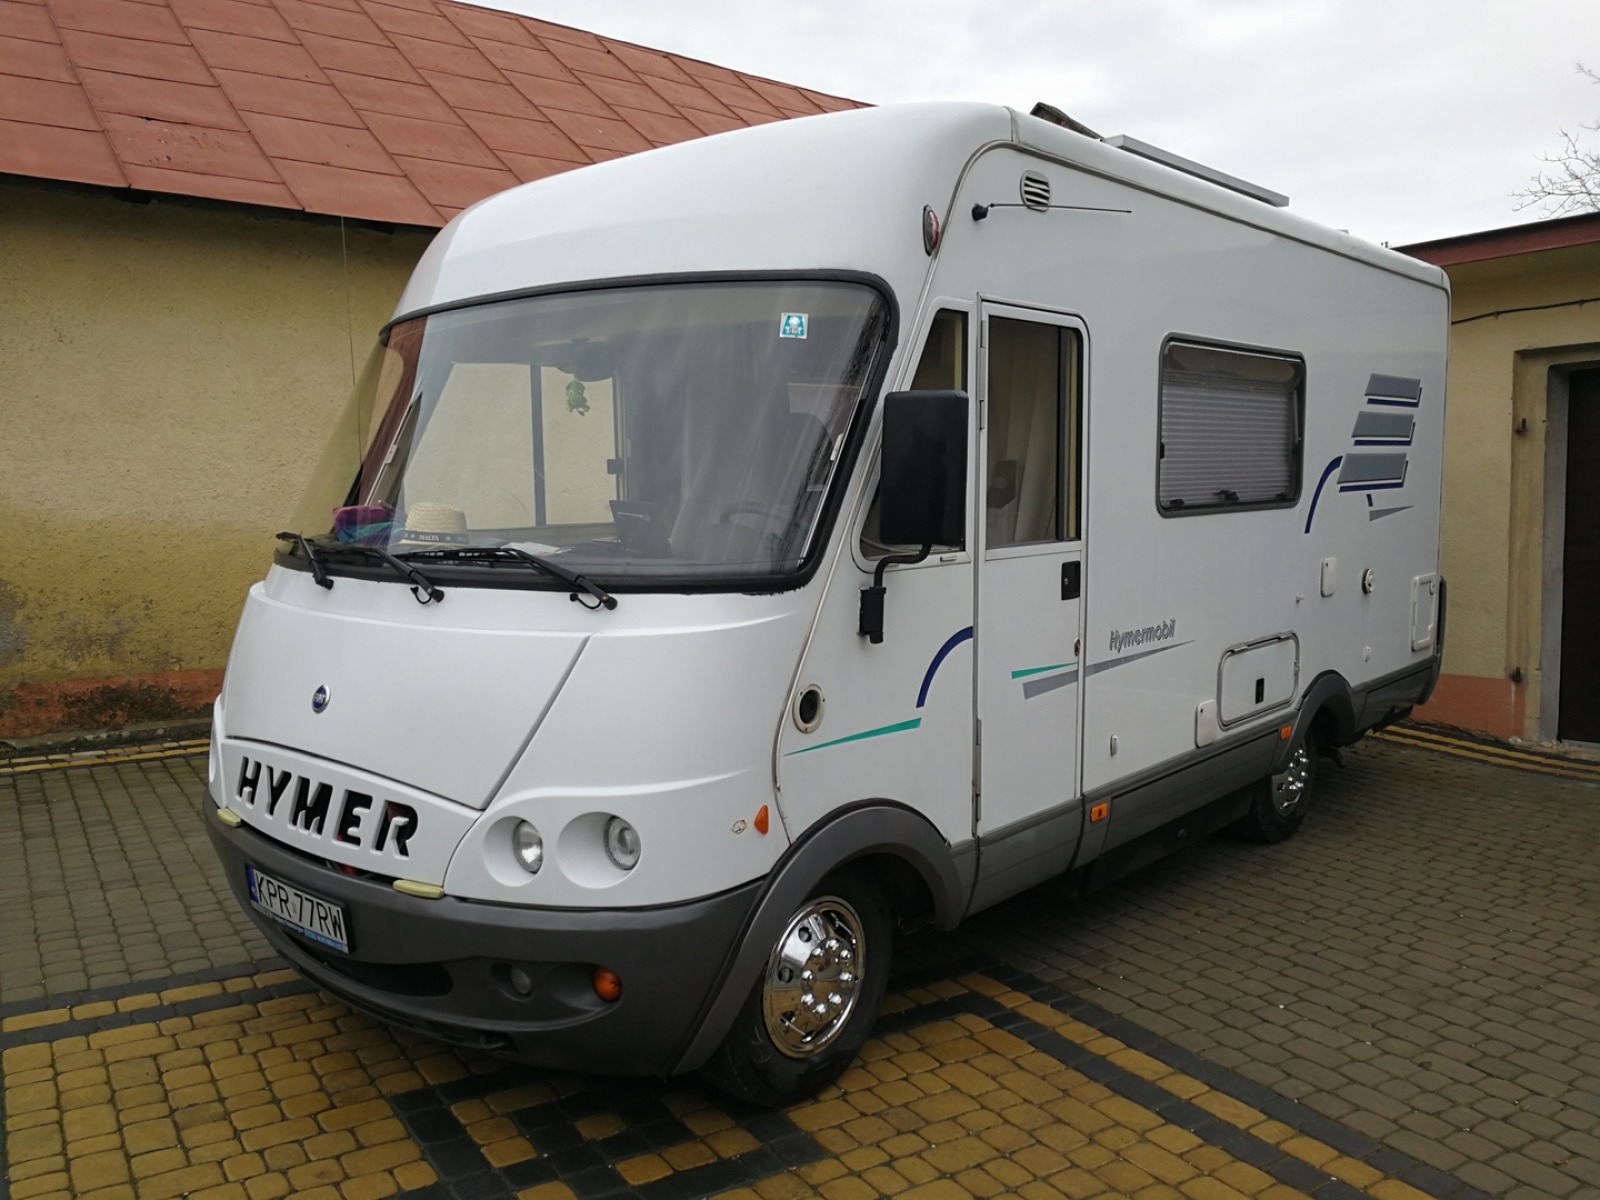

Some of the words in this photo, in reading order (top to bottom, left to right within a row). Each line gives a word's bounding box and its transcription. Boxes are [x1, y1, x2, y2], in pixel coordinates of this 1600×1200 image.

[419, 533, 440, 541] MALTA
[1108, 617, 1176, 654] Hymermobil
[234, 755, 419, 861] HYMER
[255, 872, 292, 919] KPR
[293, 891, 344, 941] 77RW
